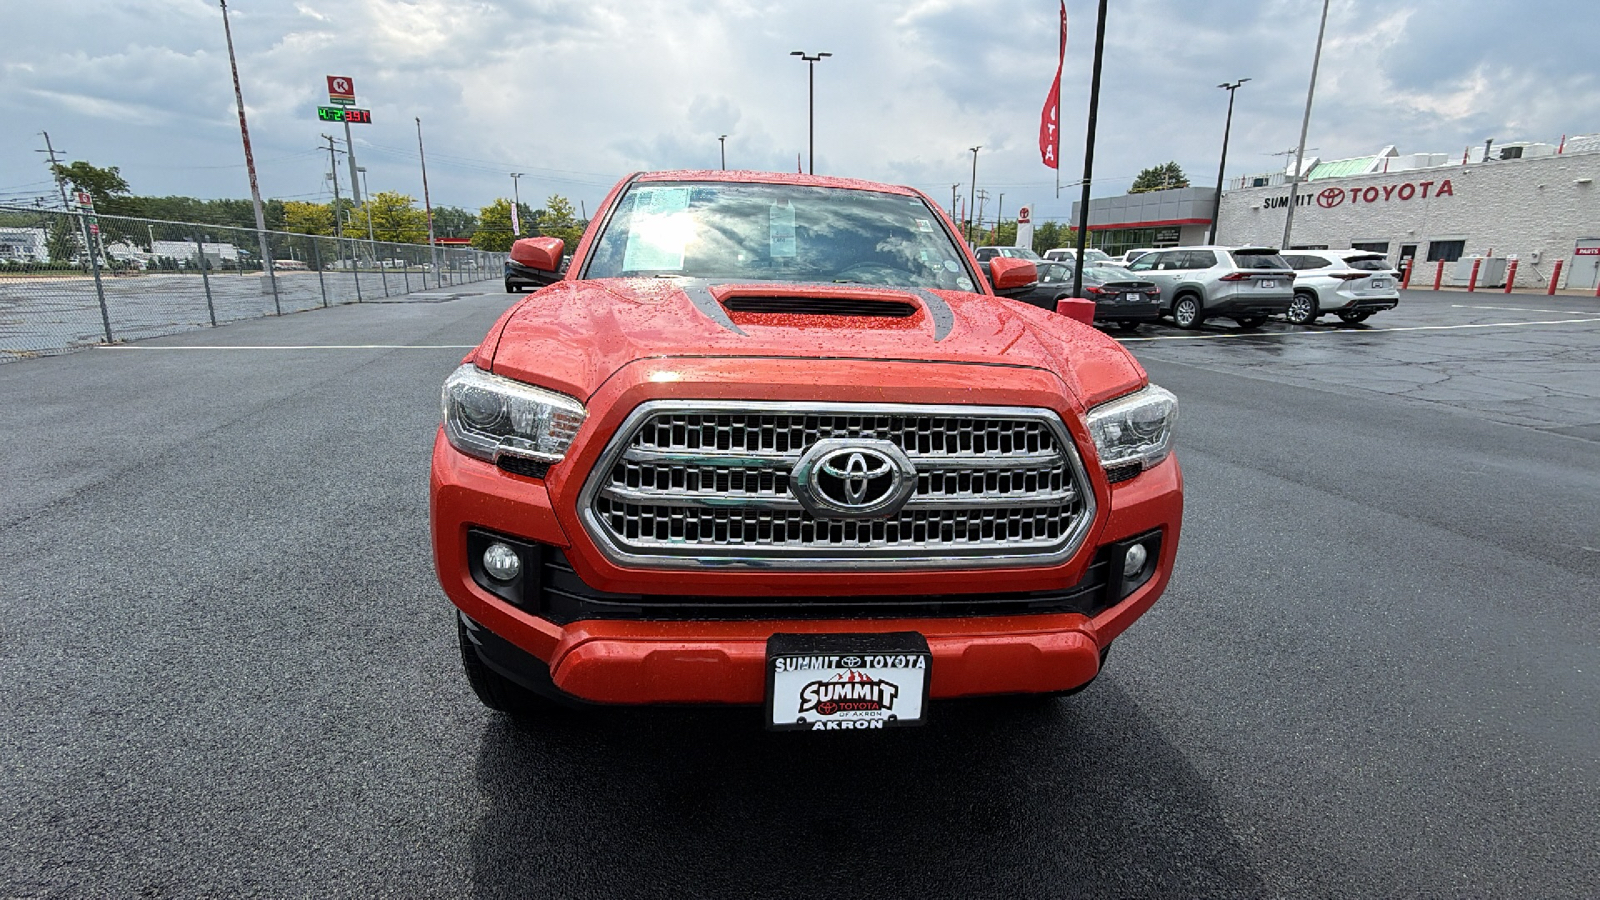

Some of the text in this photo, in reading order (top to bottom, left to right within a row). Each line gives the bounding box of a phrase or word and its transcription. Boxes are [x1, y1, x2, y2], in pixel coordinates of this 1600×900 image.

[1350, 179, 1454, 204] TOYOTA
[775, 655, 926, 673] SUMMIT TOYOTA
[802, 682, 896, 710] SUMMIT
[839, 702, 879, 710] TOYOTA
[811, 719, 884, 731] AKRON
